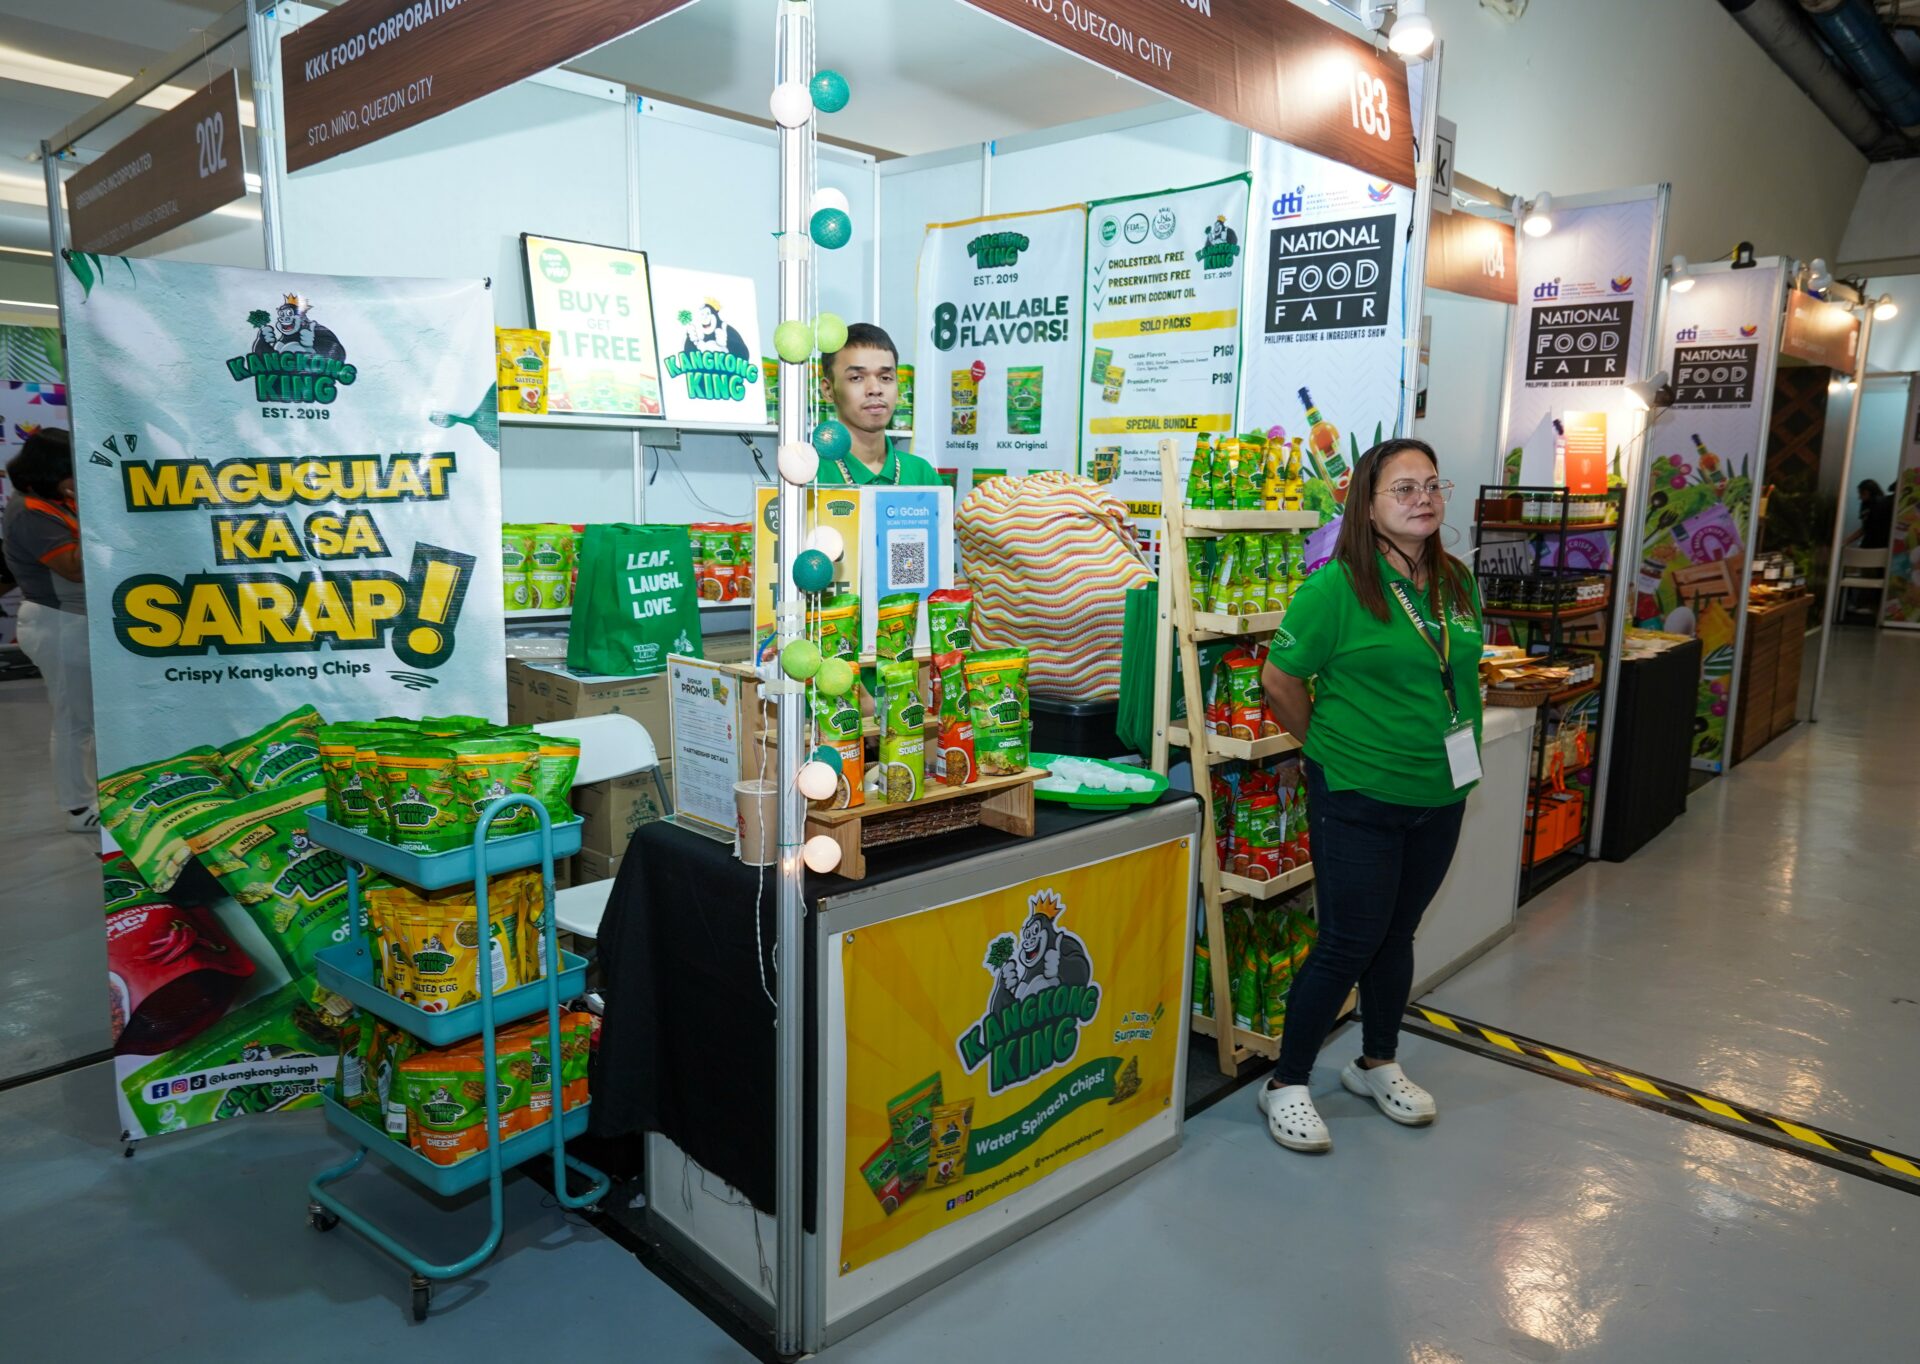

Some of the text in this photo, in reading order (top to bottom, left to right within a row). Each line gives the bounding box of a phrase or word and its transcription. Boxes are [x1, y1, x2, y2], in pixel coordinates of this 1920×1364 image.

[1062, 0, 1172, 70] QUEZON CITY
[306, 52, 329, 82] KKK
[331, 35, 366, 70] FOOD
[308, 75, 433, 147] STO. NIÑO, QUEZON CITY
[1349, 71, 1391, 141] 183
[196, 112, 227, 178] 202
[1272, 186, 1304, 216] dti
[967, 232, 1029, 258] KANGKONG
[1280, 225, 1379, 254] NATIONAL
[976, 246, 1018, 269] KING
[1108, 251, 1185, 269] CHOLESTEROL FREE
[1204, 254, 1233, 270] KING
[973, 272, 1018, 286] EST. 2019
[1108, 269, 1191, 287] PRESERVATIVES FREE
[1277, 259, 1379, 295] FOOD
[1108, 288, 1197, 306] MADE WITH COCONUT OIL
[1534, 278, 1560, 299] dti
[558, 288, 631, 317] BUY 5
[1275, 298, 1375, 325] FAIR
[587, 318, 610, 330] GET
[931, 296, 1069, 351] 8 AVAILABLE
[1140, 317, 1192, 332] SOLO PACKS
[1539, 308, 1620, 325] NATIONAL
[961, 319, 1069, 348] FLAVORS!
[1265, 333, 1294, 344] PHILIPPINE
[1295, 332, 1318, 342] CUISINE
[1326, 329, 1366, 340] INGREDIENTS
[1368, 328, 1387, 338] SHOW
[1537, 331, 1619, 354] FOOD
[1676, 325, 1698, 342] dti
[557, 330, 641, 363] 1 FREE
[1147, 350, 1167, 358] Flavors
[1213, 344, 1234, 357] P160
[1680, 348, 1748, 361] NATIONAL
[226, 351, 357, 385] KANGKONG
[664, 350, 758, 384] KANGKONG
[1534, 359, 1616, 375] FAIR
[1678, 366, 1747, 384] FOOD
[256, 374, 337, 403] KING
[686, 370, 746, 401] KING
[1675, 387, 1745, 400] FAIR
[262, 407, 330, 420] EST. 2019
[1126, 418, 1198, 430] SPECIAL BUNDLE
[946, 441, 979, 450] Salted Egg
[996, 441, 1048, 451] KKK Original
[125, 455, 453, 508] MAGUGULAT
[900, 506, 930, 517] GCash
[217, 514, 383, 561] KA SA
[627, 550, 674, 570] LEAF.
[628, 571, 683, 595] LAUGH.
[124, 560, 462, 656] SARAP!
[632, 598, 676, 619] LOVE.
[1397, 587, 1426, 628] NATIONAL
[165, 660, 372, 685] Crispy Kangkong Chips
[681, 683, 710, 699] PROMO!
[710, 753, 729, 764] DETAILS
[162, 806, 199, 829] SWEET
[398, 812, 432, 826] KING
[239, 831, 263, 846] 100%
[439, 984, 458, 994] EGG
[958, 983, 1101, 1072] KANGKONG
[1122, 1011, 1150, 1024] A Tasty
[1114, 1029, 1153, 1043] Surprise!
[990, 1018, 1079, 1093] KING
[208, 1063, 319, 1086] @kangkongkingph
[976, 1068, 1106, 1156] Water Spinach Chips!
[427, 1138, 460, 1148] CHEESE
